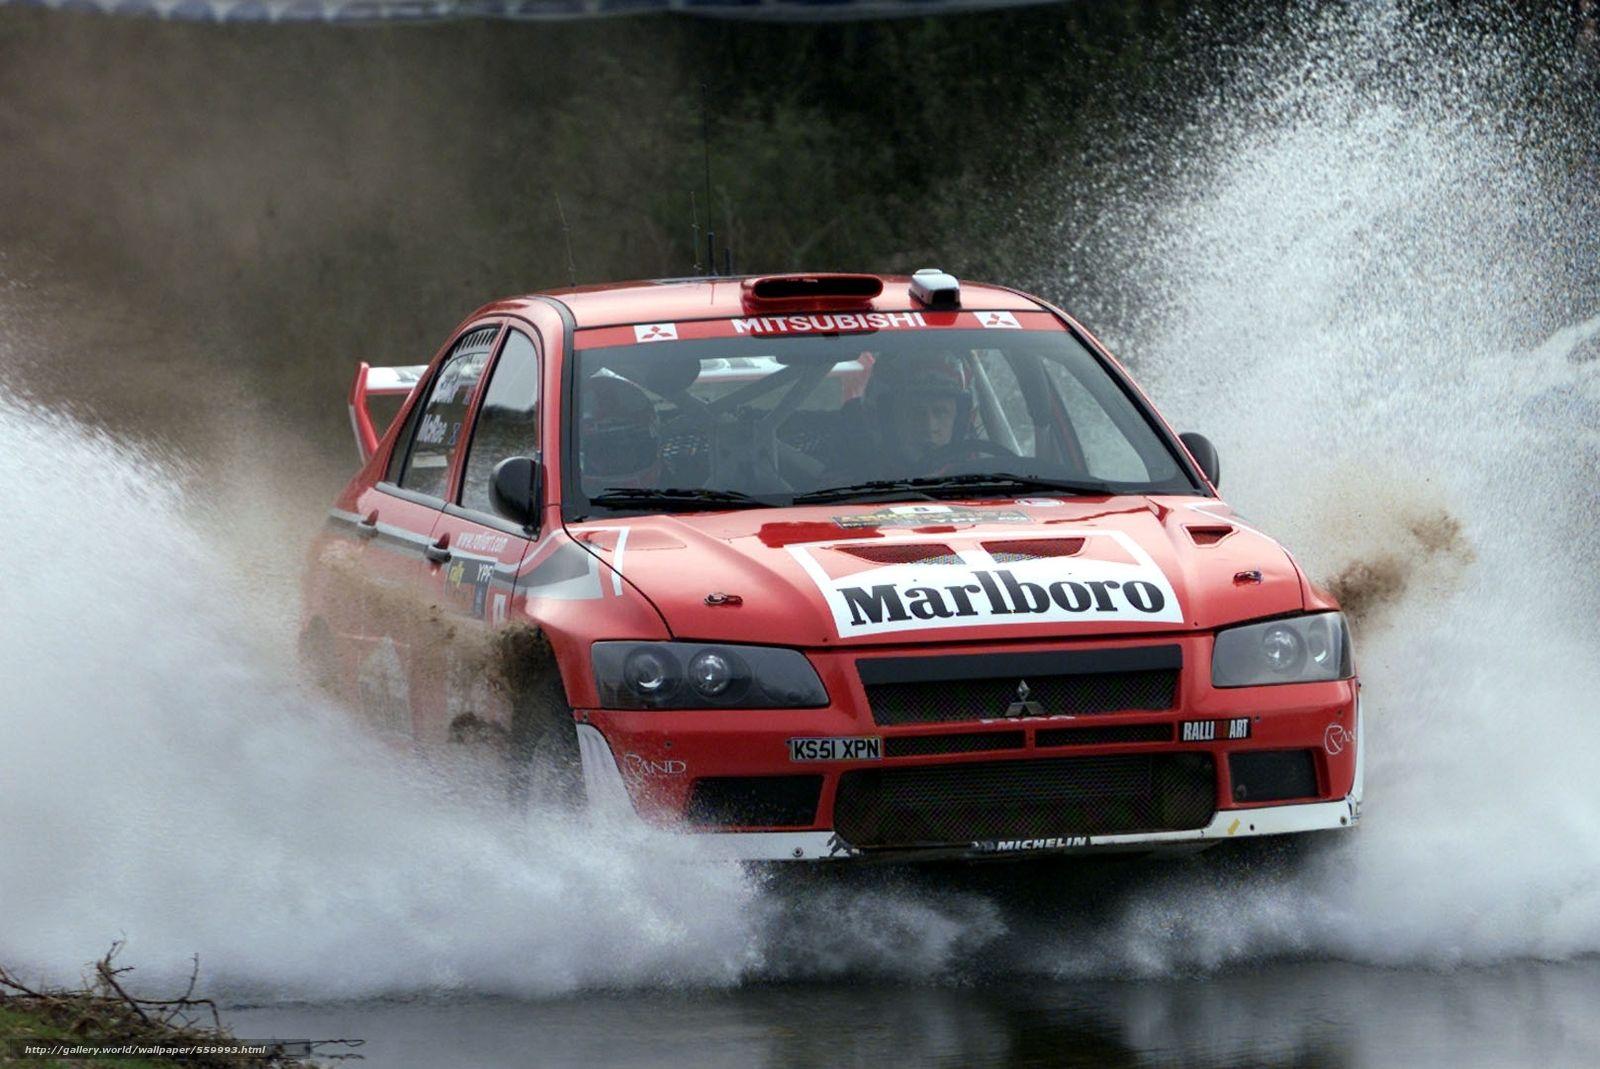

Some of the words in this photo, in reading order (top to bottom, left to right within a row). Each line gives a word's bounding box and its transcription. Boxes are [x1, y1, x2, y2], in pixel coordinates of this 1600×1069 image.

[731, 312, 927, 333] MITSUBISHI
[837, 570, 1165, 626] Marlboro
[1183, 721, 1215, 741] RALLI
[1229, 719, 1249, 739] ART
[794, 740, 836, 759] KS51
[842, 739, 879, 759] XPN
[997, 836, 1087, 851] MICHELIN
